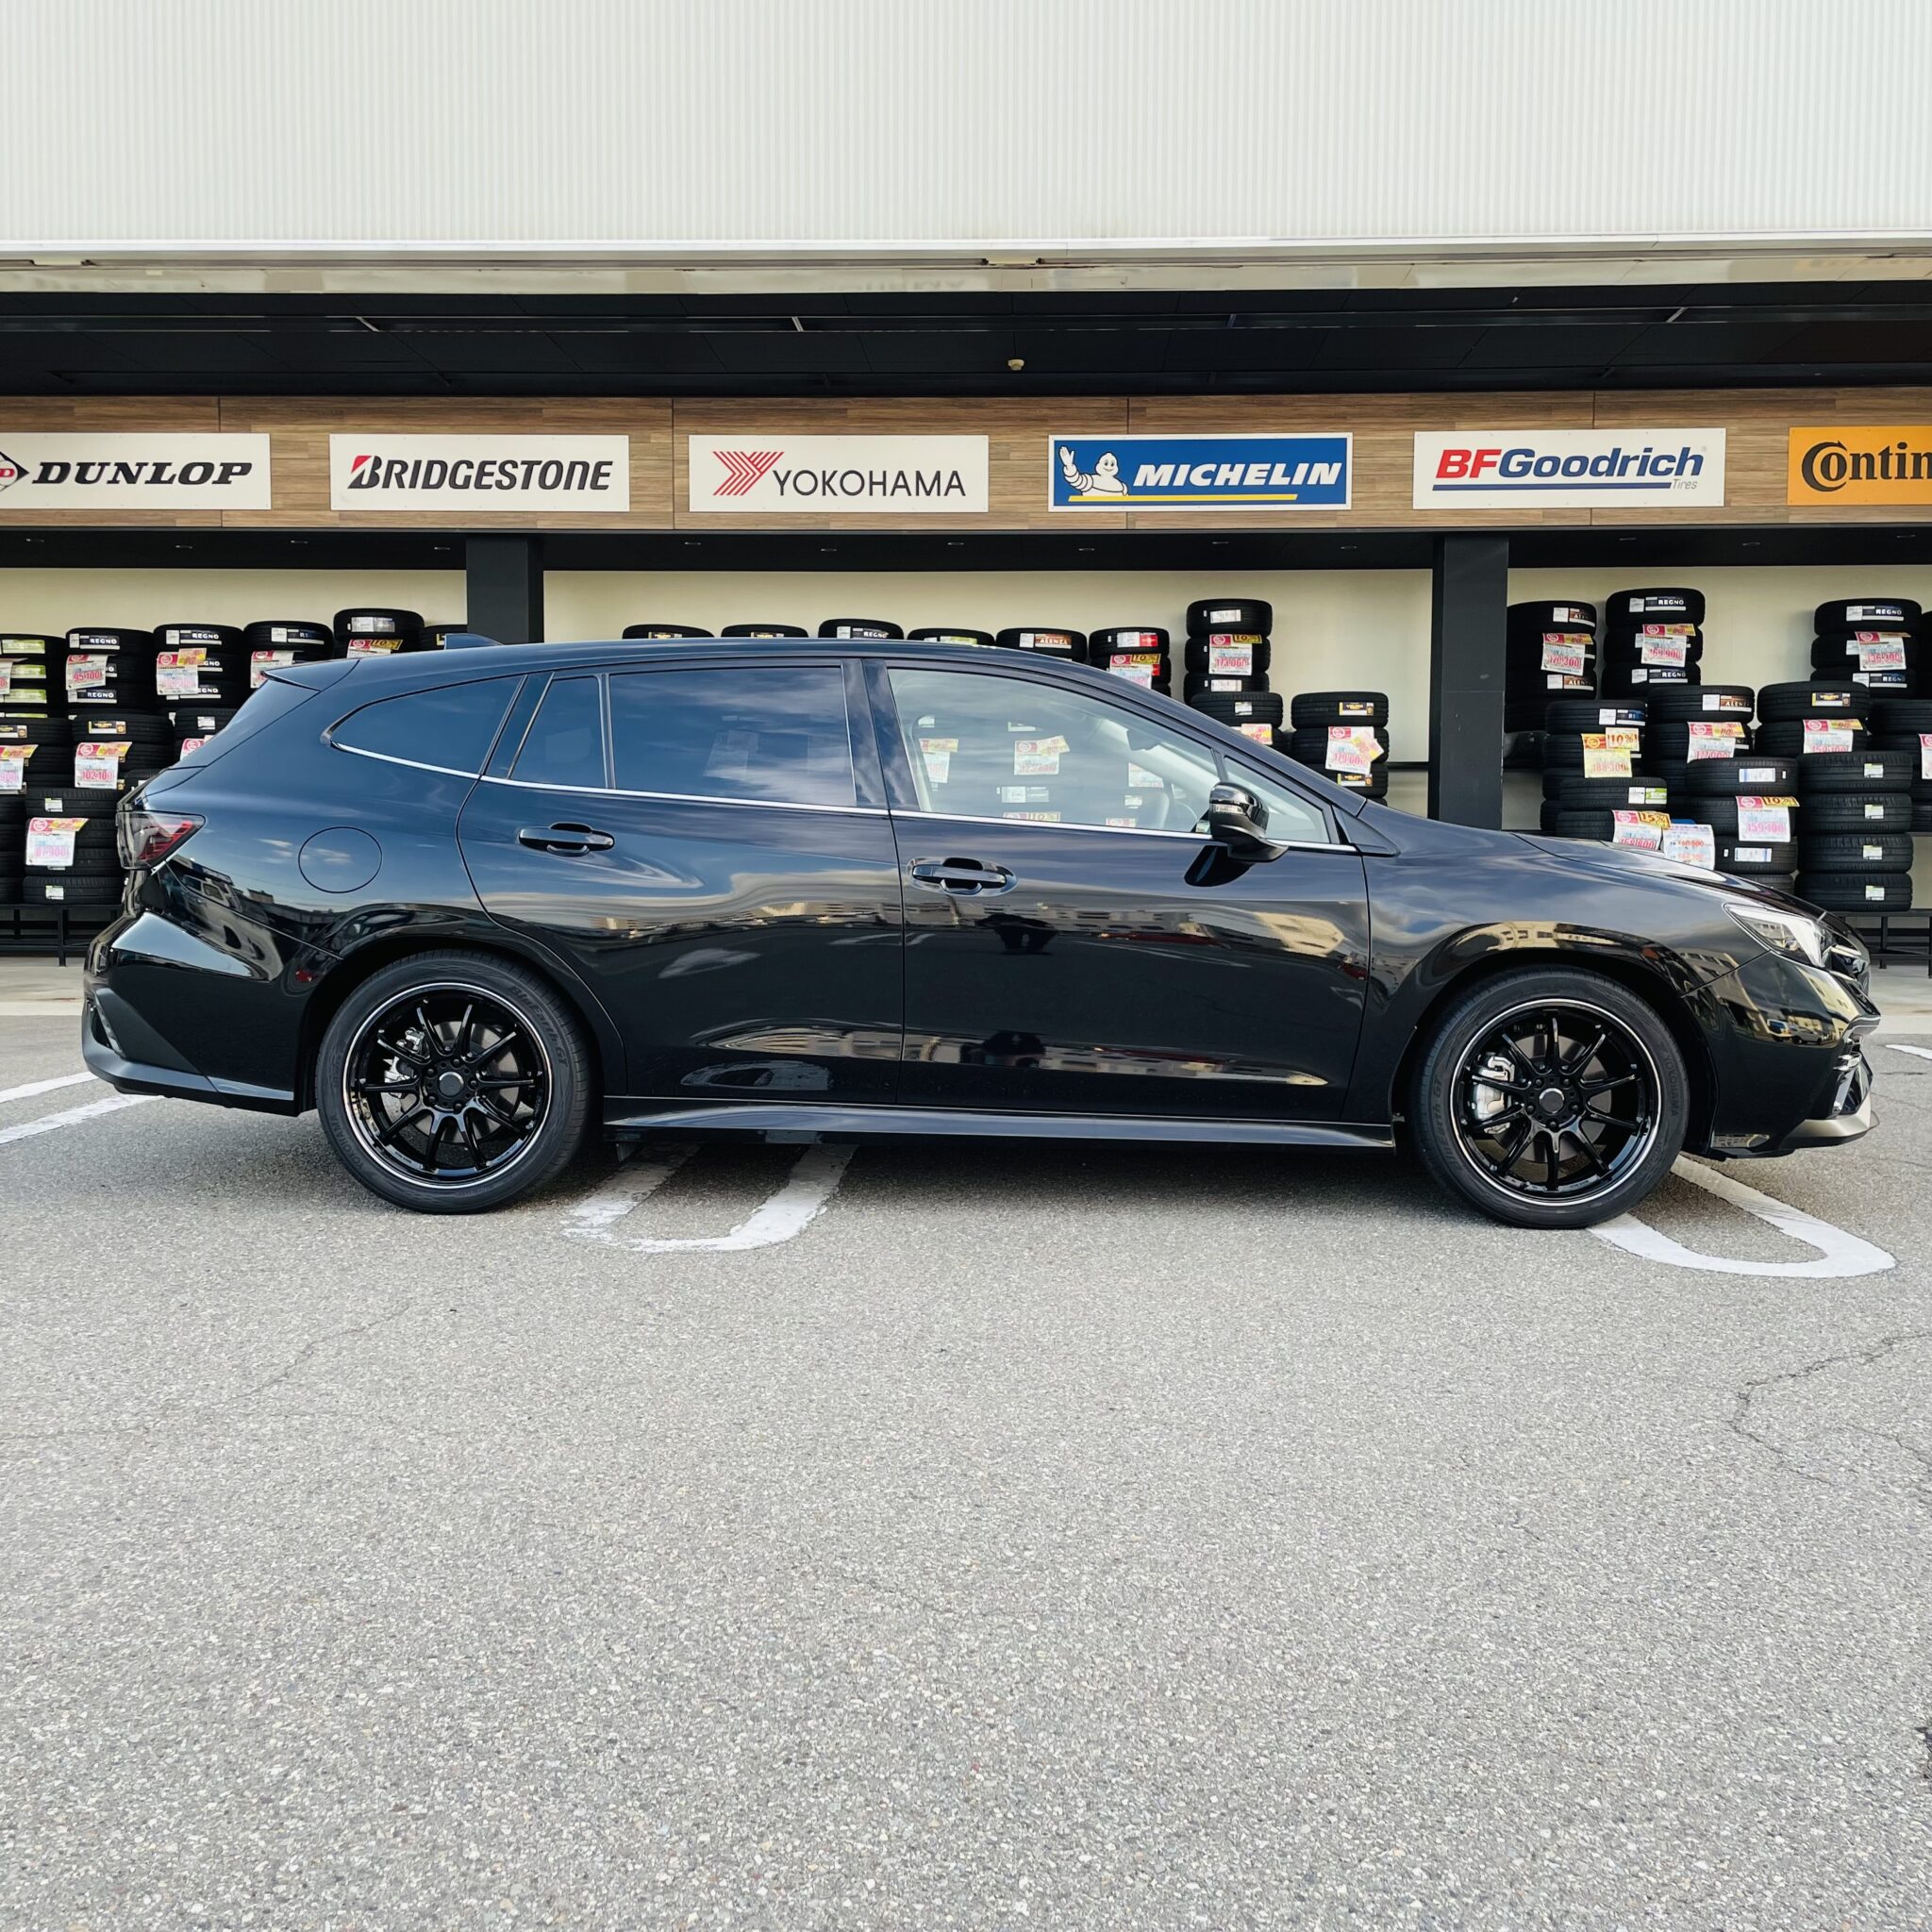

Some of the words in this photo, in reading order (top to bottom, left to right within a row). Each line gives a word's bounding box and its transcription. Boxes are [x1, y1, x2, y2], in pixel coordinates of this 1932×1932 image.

[32, 461, 253, 485] DUNLOP
[347, 455, 613, 491] BRIDGESTONE
[1132, 461, 1342, 488] MICHELIN
[1436, 446, 1705, 479] BFGoodrich
[1801, 441, 1932, 492] Contin
[773, 469, 966, 497] YOKOHAMA
[1673, 478, 1698, 490] Tires
[1665, 1055, 1680, 1118] YOKOHAMA
[330, 1113, 365, 1174] YOKOHAMA
